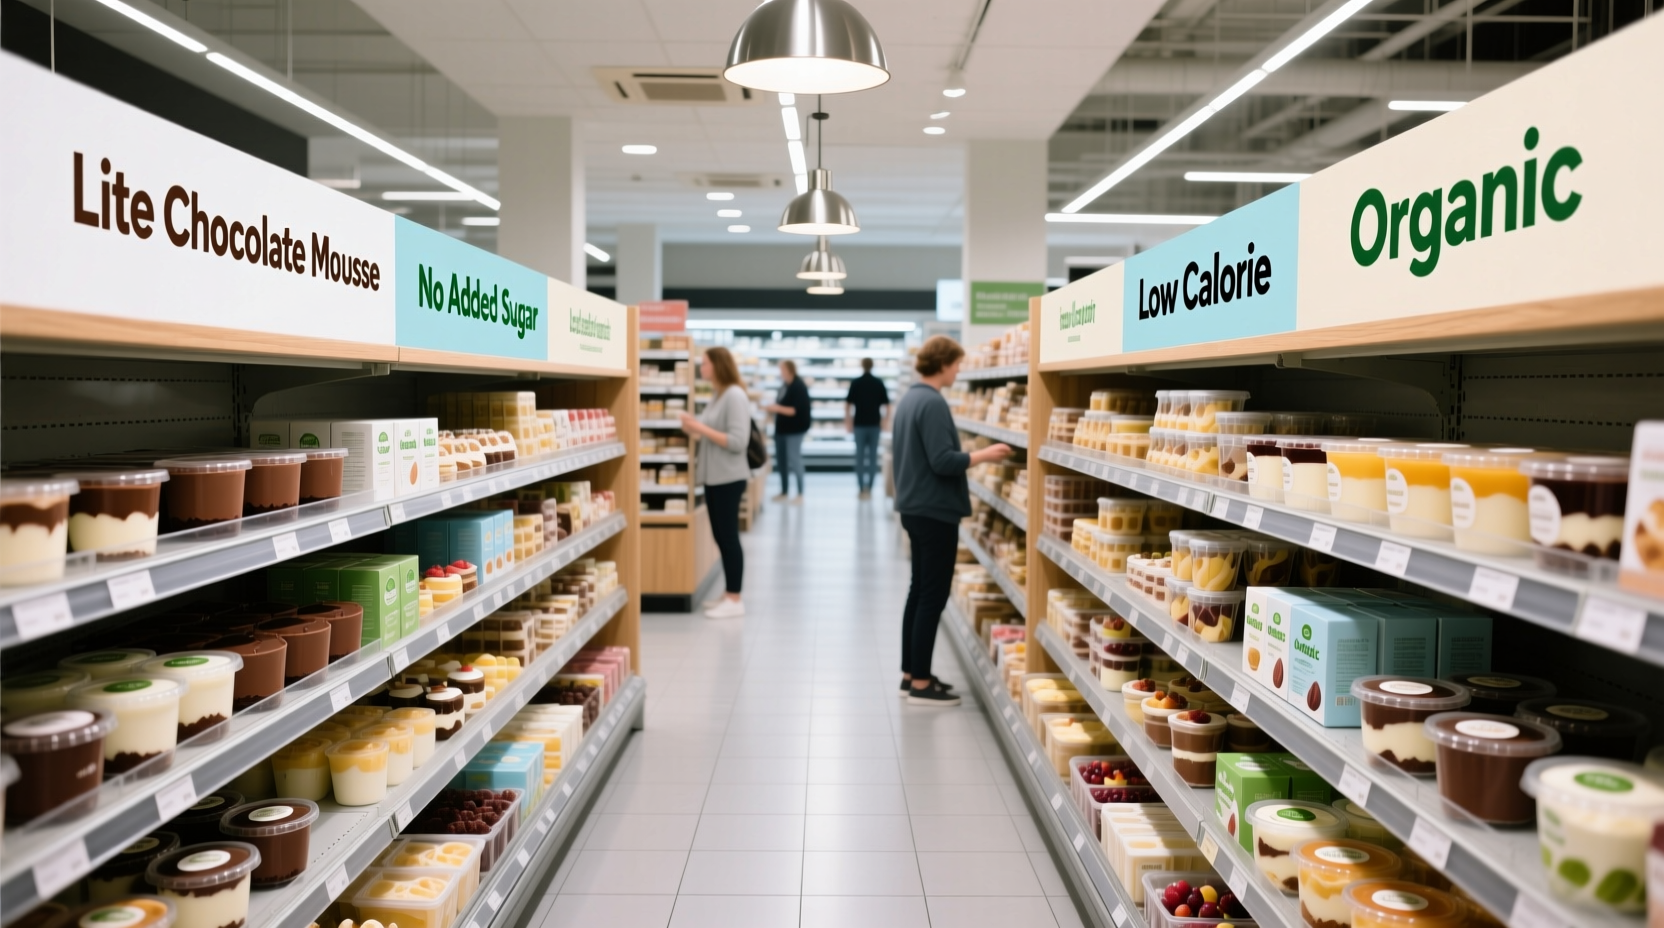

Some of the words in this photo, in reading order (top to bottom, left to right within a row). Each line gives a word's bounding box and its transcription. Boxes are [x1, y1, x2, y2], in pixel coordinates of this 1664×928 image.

[73, 151, 154, 239] Lite
[164, 185, 306, 274] Chocolate
[312, 230, 380, 291] Mousse
[1351, 126, 1583, 277] Organic
[419, 264, 444, 312] No
[448, 272, 498, 323] Added
[502, 288, 538, 339] Sugar
[1139, 277, 1179, 320] Low
[1183, 242, 1272, 310] Calorie
